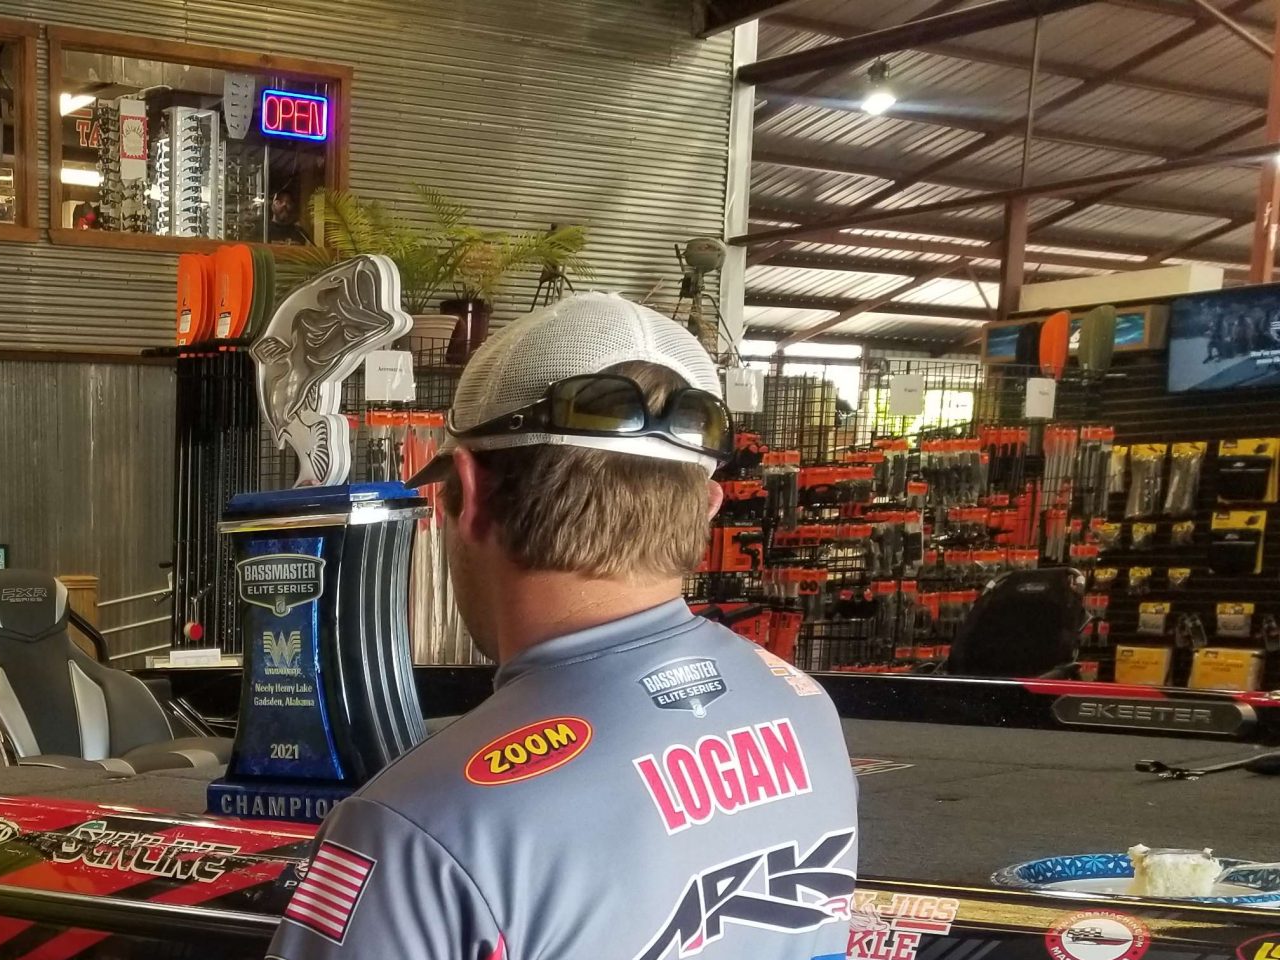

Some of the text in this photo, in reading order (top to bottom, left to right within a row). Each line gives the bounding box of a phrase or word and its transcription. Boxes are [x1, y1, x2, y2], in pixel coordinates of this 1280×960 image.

[265, 96, 325, 135] OPEN
[244, 562, 316, 581] BASSMASTER
[247, 584, 314, 594] ELITE SERIES
[255, 682, 313, 693] Neely Henry Lake
[642, 661, 719, 693] BASSMASTER
[254, 697, 314, 706] Gadsden, Alabama
[657, 681, 722, 705] ELITE SERIES
[1078, 702, 1211, 724] SKEETER
[270, 744, 299, 759] 2021
[484, 723, 577, 774] ZOOM
[632, 718, 812, 836] LOGAN
[53, 820, 241, 884] SUNLINE
